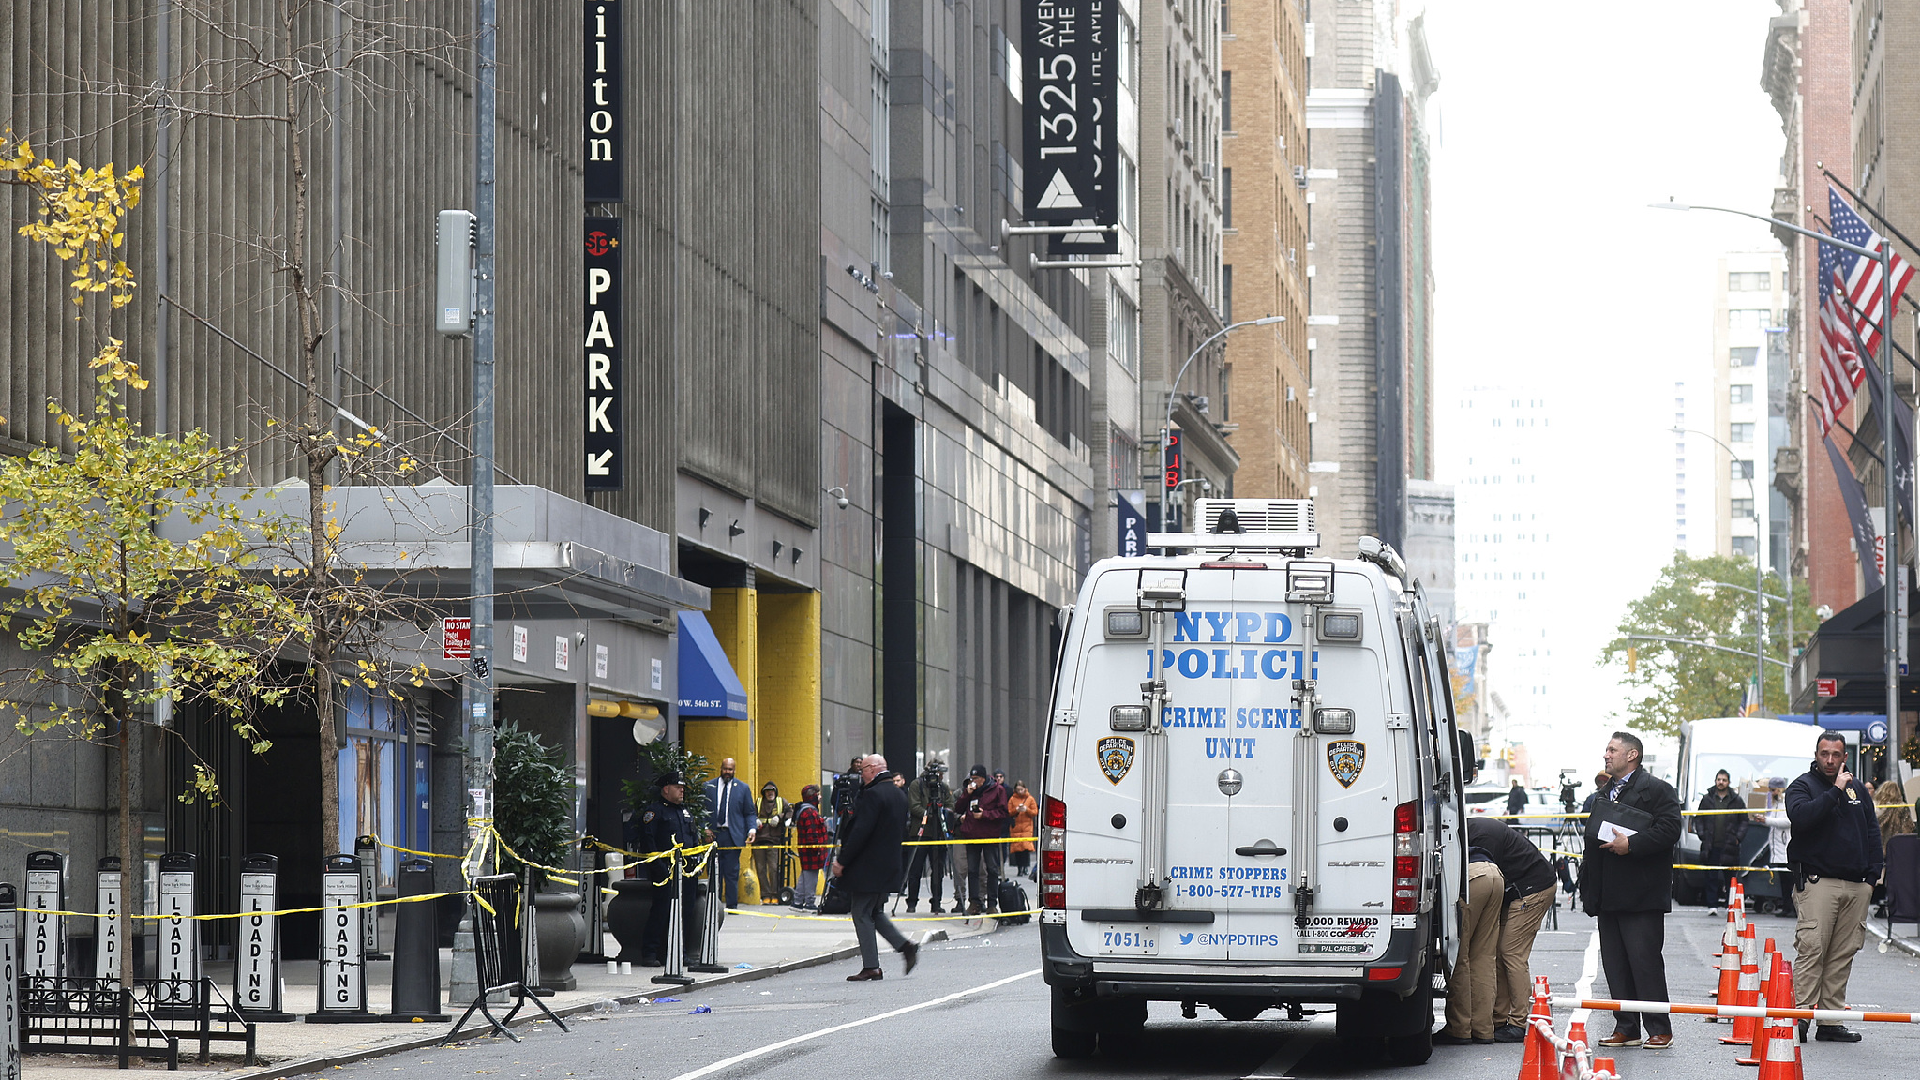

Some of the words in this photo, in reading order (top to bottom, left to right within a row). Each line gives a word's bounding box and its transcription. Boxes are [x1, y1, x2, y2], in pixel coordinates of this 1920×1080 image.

[1058, 7, 1075, 47] THE
[587, 0, 614, 161] ilton
[1039, 54, 1077, 159] 1325
[585, 268, 614, 433] PARK
[446, 621, 456, 630] NO
[1173, 611, 1292, 643] NYPD
[445, 639, 463, 647] Loading
[1147, 649, 1318, 680] POLICE
[683, 699, 693, 707] W.
[694, 699, 709, 708] 54th
[710, 700, 722, 708] ST.
[1161, 707, 1226, 728] CRIME
[1236, 708, 1302, 729] SCENE
[1205, 738, 1256, 758] UNIT
[1170, 866, 1213, 879] CRIME
[1219, 867, 1287, 880] STOPPERS
[1176, 885, 1282, 898] 1-800-577-TIPS
[1294, 917, 1333, 926] $0,000
[1337, 917, 1378, 926] REWARD
[1103, 932, 1140, 947] 7051
[1143, 939, 1154, 948] 16
[1197, 934, 1278, 946] @NYPDTIPS
[1297, 930, 1310, 938] CALL
[248, 898, 263, 1003] LOADING
[336, 898, 349, 1003] LOADING
[5, 944, 18, 1080] LOADING
